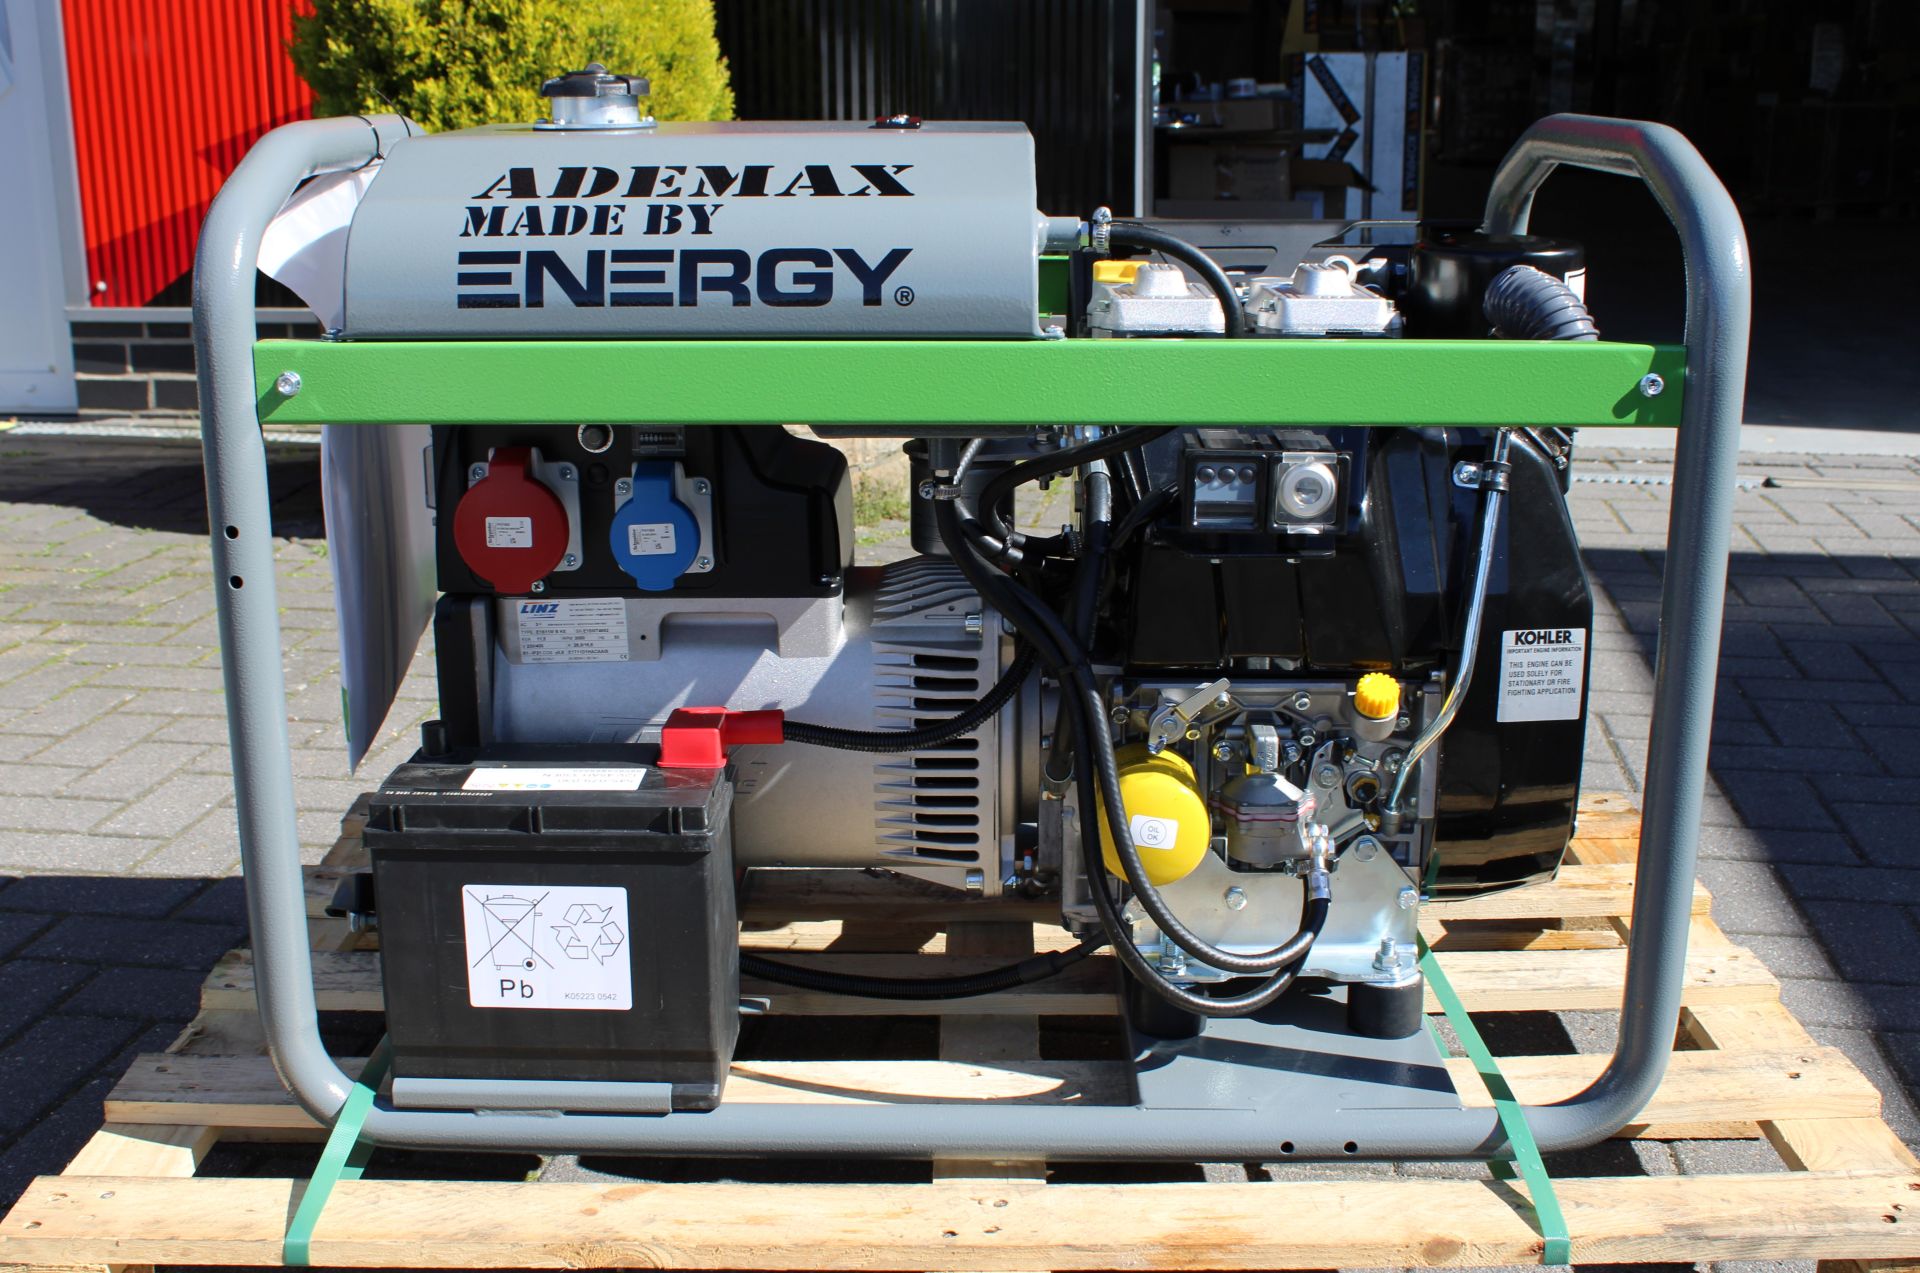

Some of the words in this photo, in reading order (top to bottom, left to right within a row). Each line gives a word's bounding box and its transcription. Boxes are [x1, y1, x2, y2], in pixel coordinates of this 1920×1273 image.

[471, 164, 916, 199] ADEMAX
[459, 204, 627, 238] MADE
[643, 203, 725, 236] BY
[457, 247, 914, 308] ENERGY
[520, 603, 559, 613] LINZ
[1514, 630, 1573, 645] KOHLER
[1565, 659, 1573, 667] BE
[1507, 688, 1536, 696] FIGHTING
[1537, 687, 1576, 695] APPLICATION
[1148, 825, 1160, 833] OIL
[500, 979, 534, 999] Pb
[597, 992, 617, 1000] 0542
